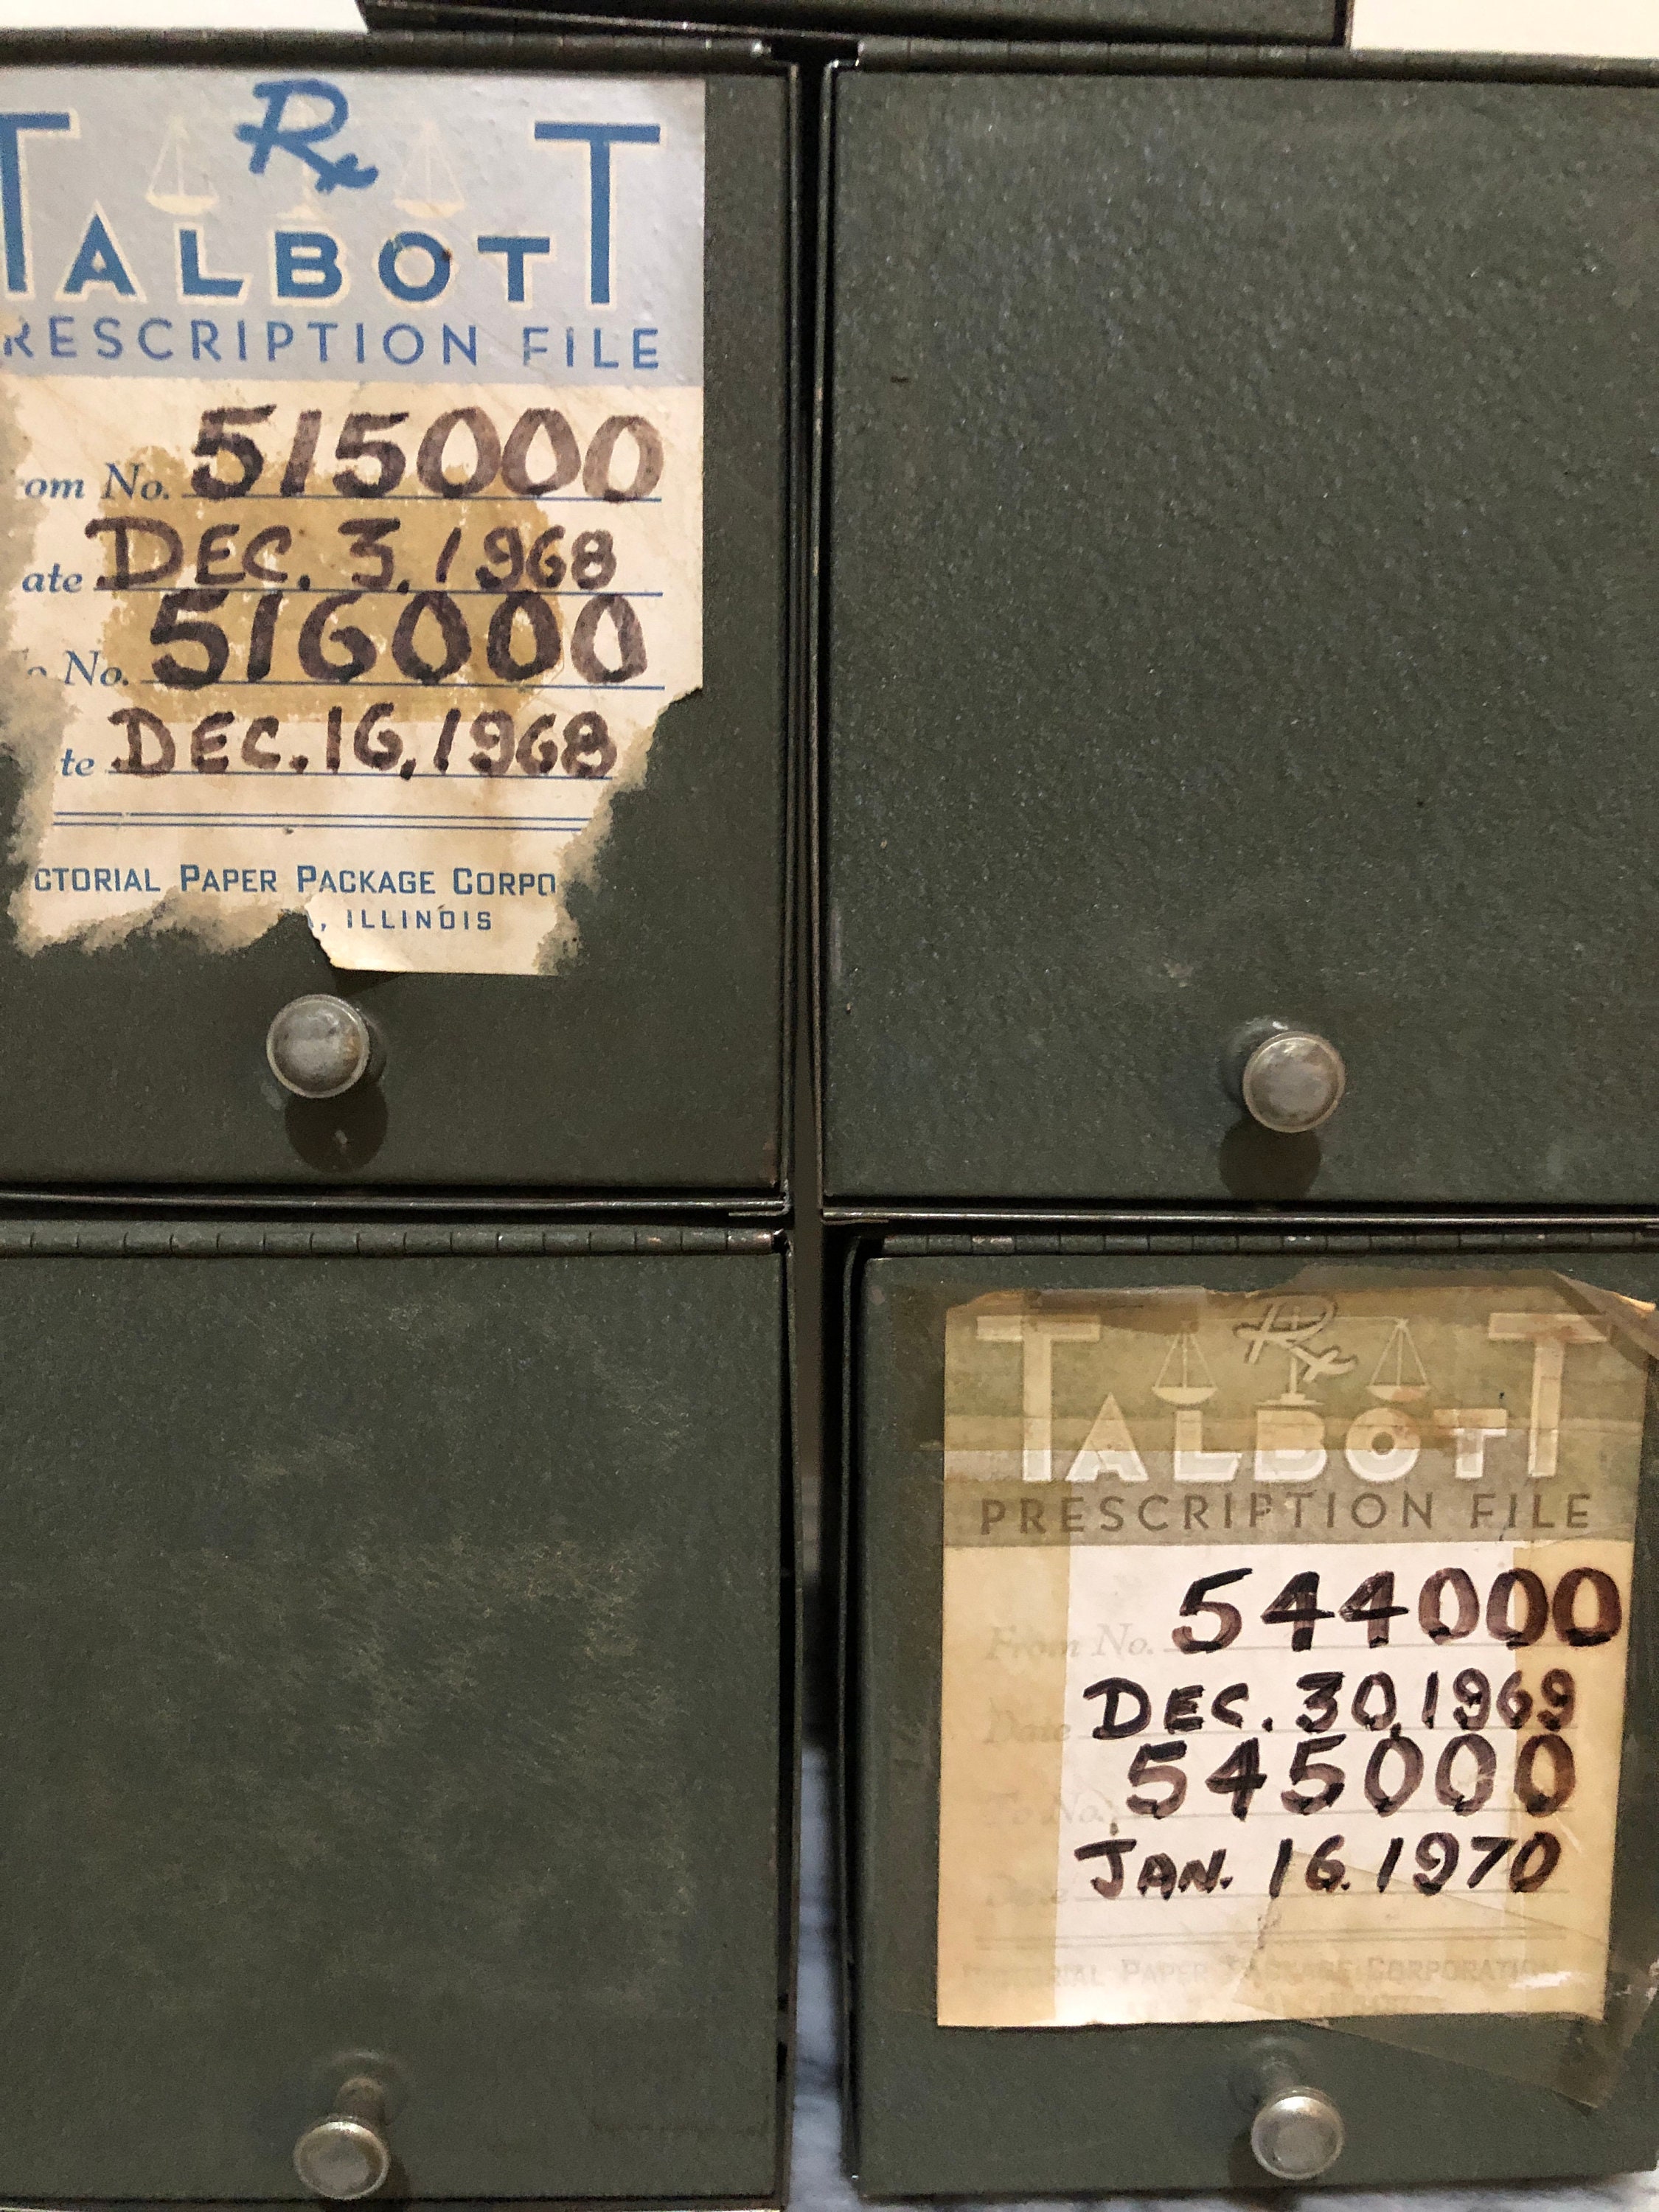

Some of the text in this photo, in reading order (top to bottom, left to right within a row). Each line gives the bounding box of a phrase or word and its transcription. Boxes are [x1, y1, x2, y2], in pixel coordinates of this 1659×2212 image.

[0, 112, 662, 305] TALBOTT
[523, 325, 660, 369] FILE
[101, 462, 170, 500] No.
[191, 403, 664, 503] 515000
[85, 515, 310, 591] DEC.
[436, 524, 618, 591] 1968
[64, 649, 130, 686] No.
[150, 589, 648, 690] 516000
[433, 707, 618, 779] 1968
[180, 863, 278, 893] PAPER
[297, 864, 436, 895] PACKAGE
[347, 908, 493, 931] ILLINOIS
[975, 1312, 1608, 1483] TALBOTT
[981, 1490, 1591, 1535] PRESCRIPTION FILE
[1091, 1622, 1155, 1658] No.
[1171, 1567, 1623, 1654] 544000
[1082, 1677, 1274, 1741] DEC.
[1421, 1667, 1576, 1732] 1969
[1125, 1732, 1576, 1820] 545000
[1074, 1837, 1234, 1901] JAN.
[1377, 1831, 1562, 1896] 1970
